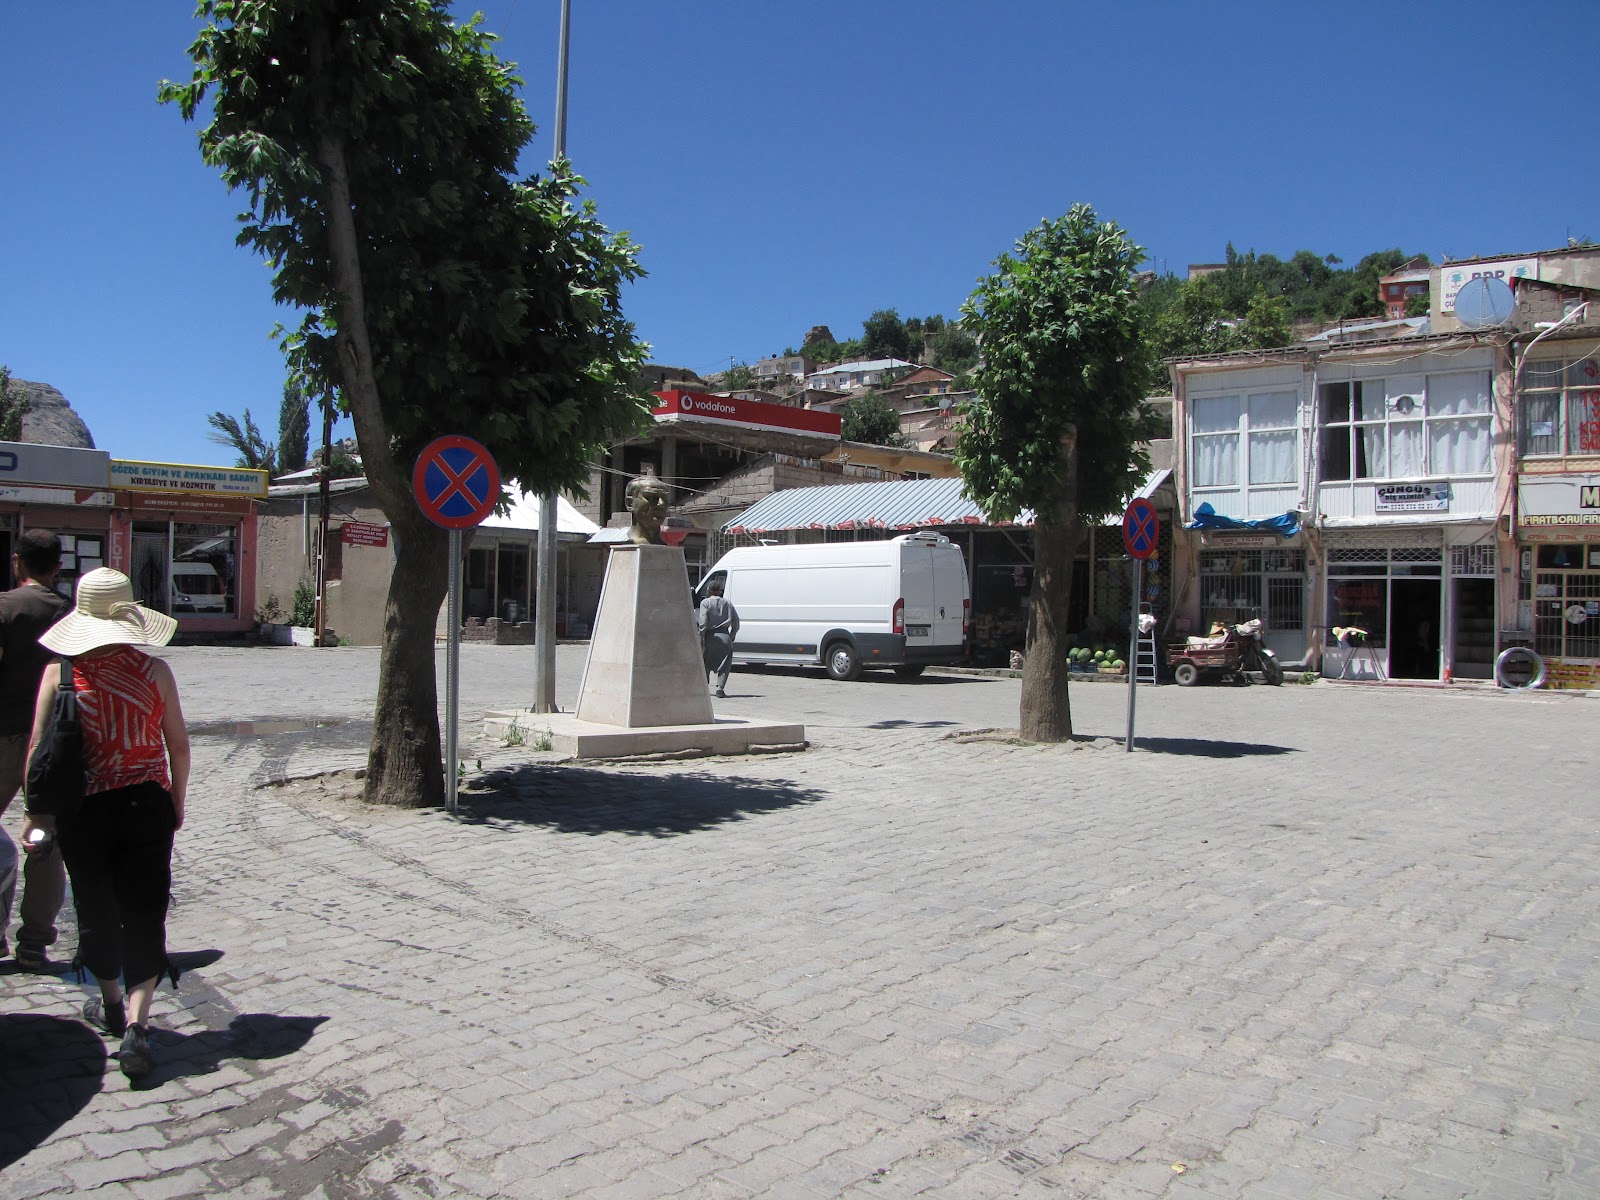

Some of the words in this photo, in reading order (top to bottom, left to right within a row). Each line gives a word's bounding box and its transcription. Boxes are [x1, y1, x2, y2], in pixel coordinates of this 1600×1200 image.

[694, 401, 736, 414] vodafone
[111, 463, 139, 475] GÖZDE
[142, 466, 169, 477] GİYİM
[171, 469, 182, 479] VE
[184, 470, 227, 481] AYAKKABI
[229, 474, 258, 483] SARAYI
[130, 477, 167, 487] KIRTASİYE
[169, 480, 178, 488] VE
[180, 481, 216, 490] KOZMETİK
[1524, 515, 1580, 525] FIRATBORU
[112, 531, 124, 568] FOT
